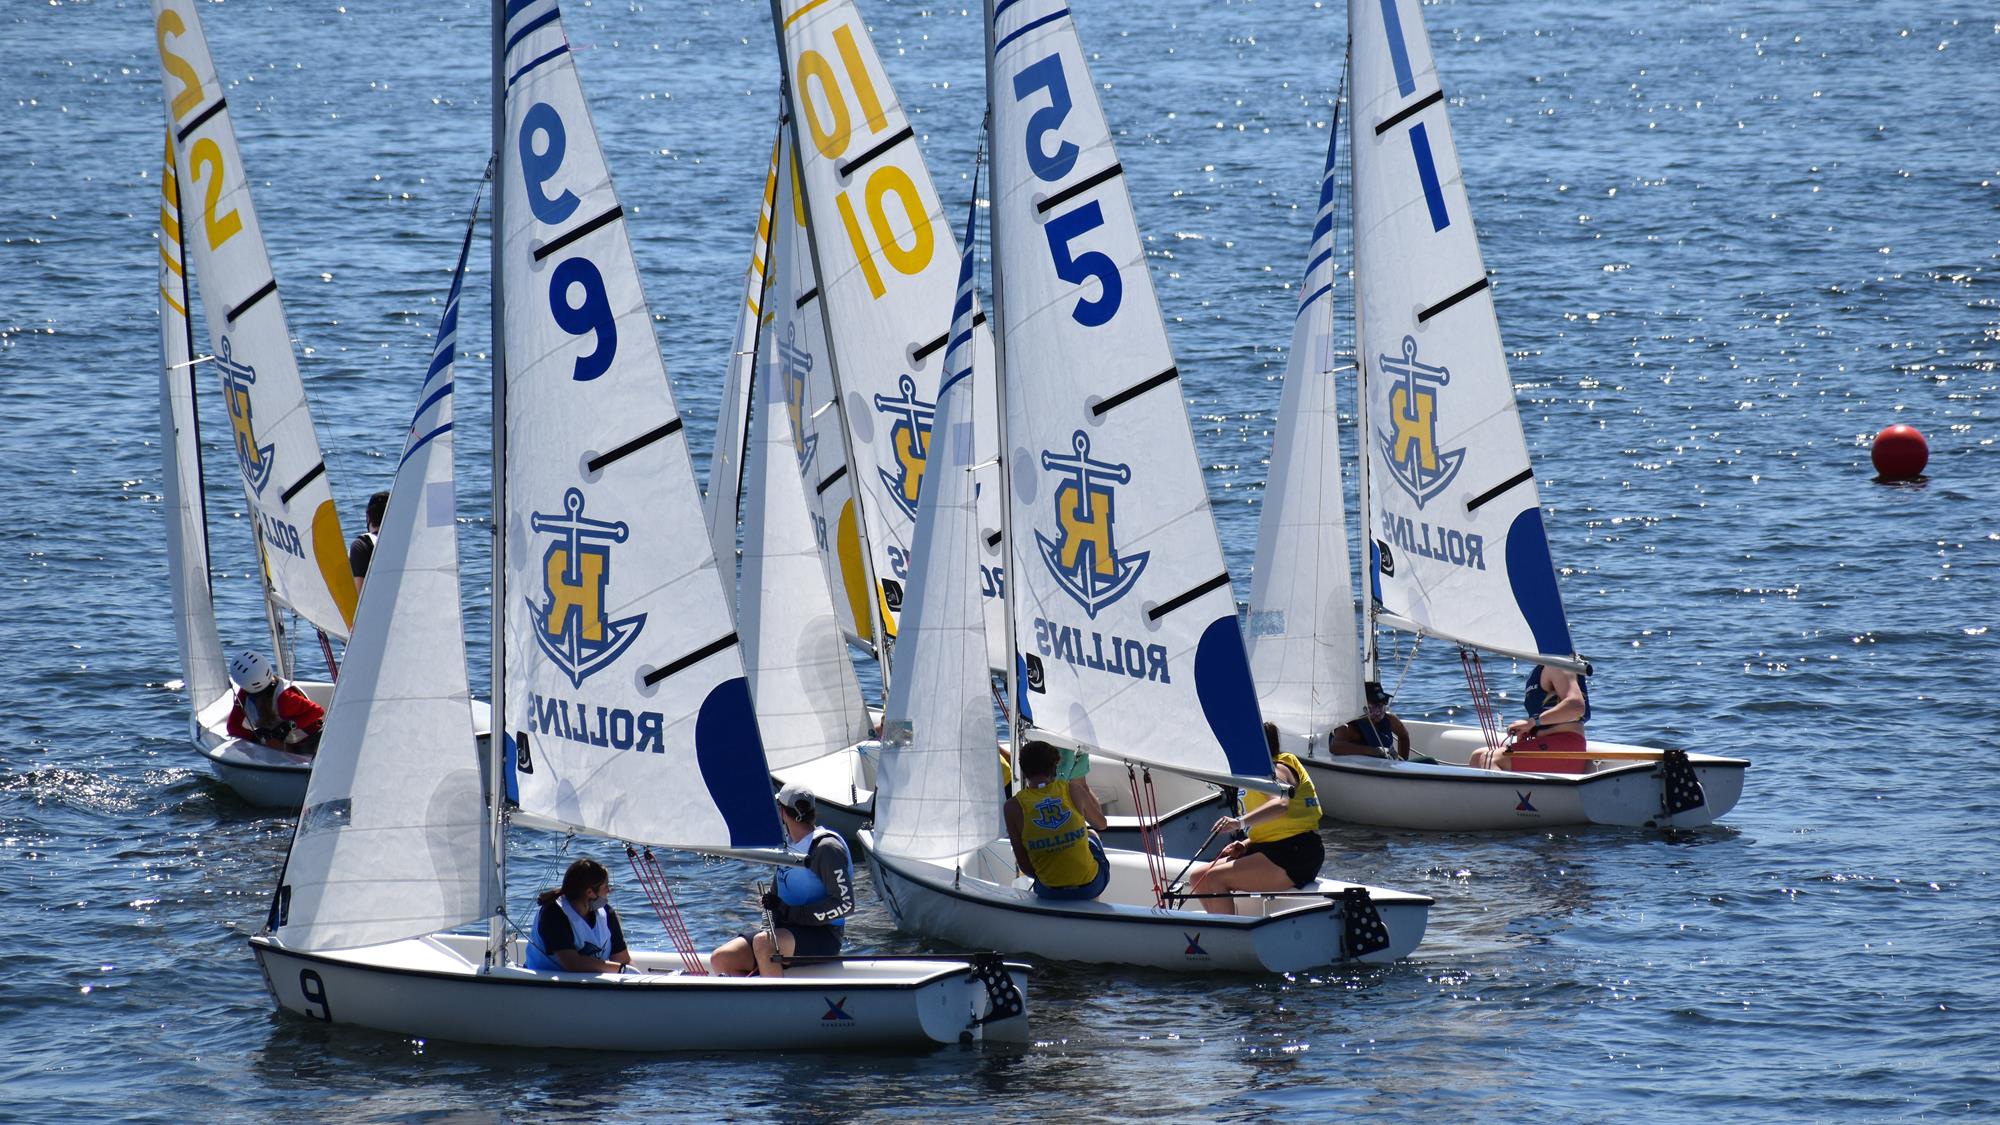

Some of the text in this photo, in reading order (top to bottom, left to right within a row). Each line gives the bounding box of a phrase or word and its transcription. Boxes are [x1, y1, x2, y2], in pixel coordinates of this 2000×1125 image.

[189, 137, 242, 251] 2
[835, 165, 935, 300] 10
[1408, 121, 1450, 233] 1
[549, 256, 617, 381] 9
[1044, 199, 1123, 327] 5
[1028, 826, 1085, 849] ROLLINS
[813, 869, 853, 921] NAUTICA
[299, 968, 332, 1022] 9
